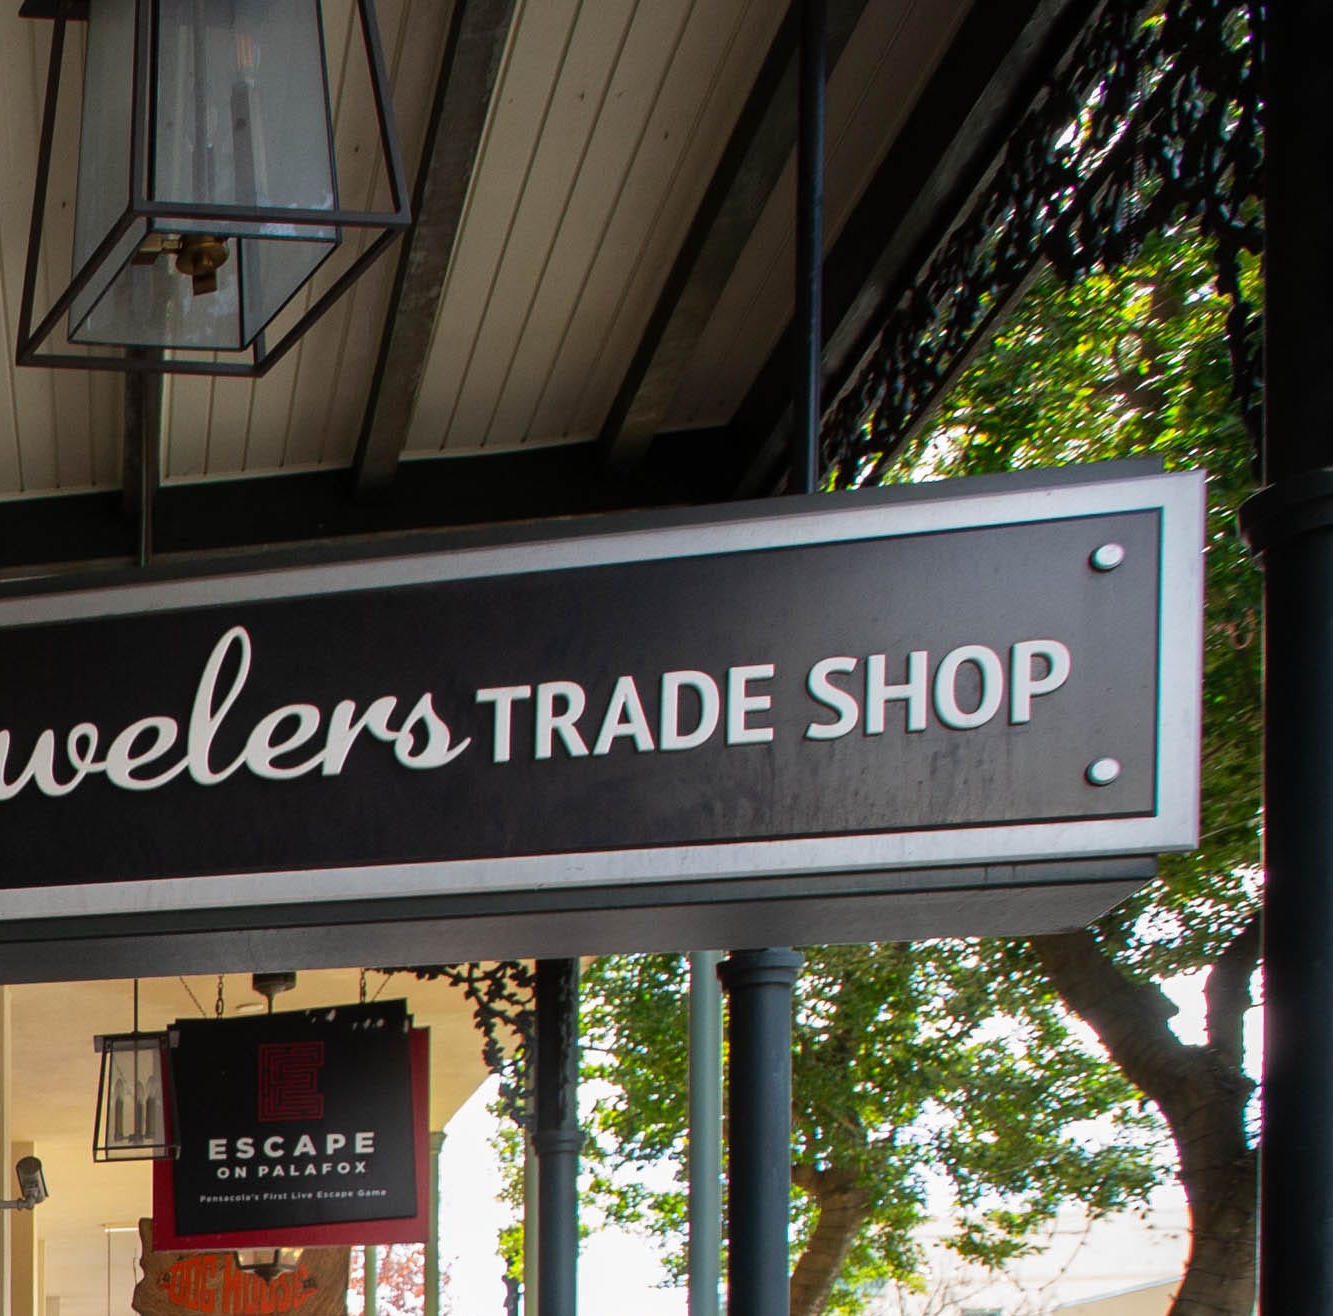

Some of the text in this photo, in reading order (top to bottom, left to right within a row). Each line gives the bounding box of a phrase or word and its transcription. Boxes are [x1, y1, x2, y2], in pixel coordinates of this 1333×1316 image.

[476, 662, 775, 763] TRADE
[805, 639, 1073, 742] SHOP
[207, 1131, 375, 1161] ESCAPE
[216, 1160, 367, 1179] ON PALAFOX
[199, 1187, 387, 1203] Pensacola's First Live Escape Game
